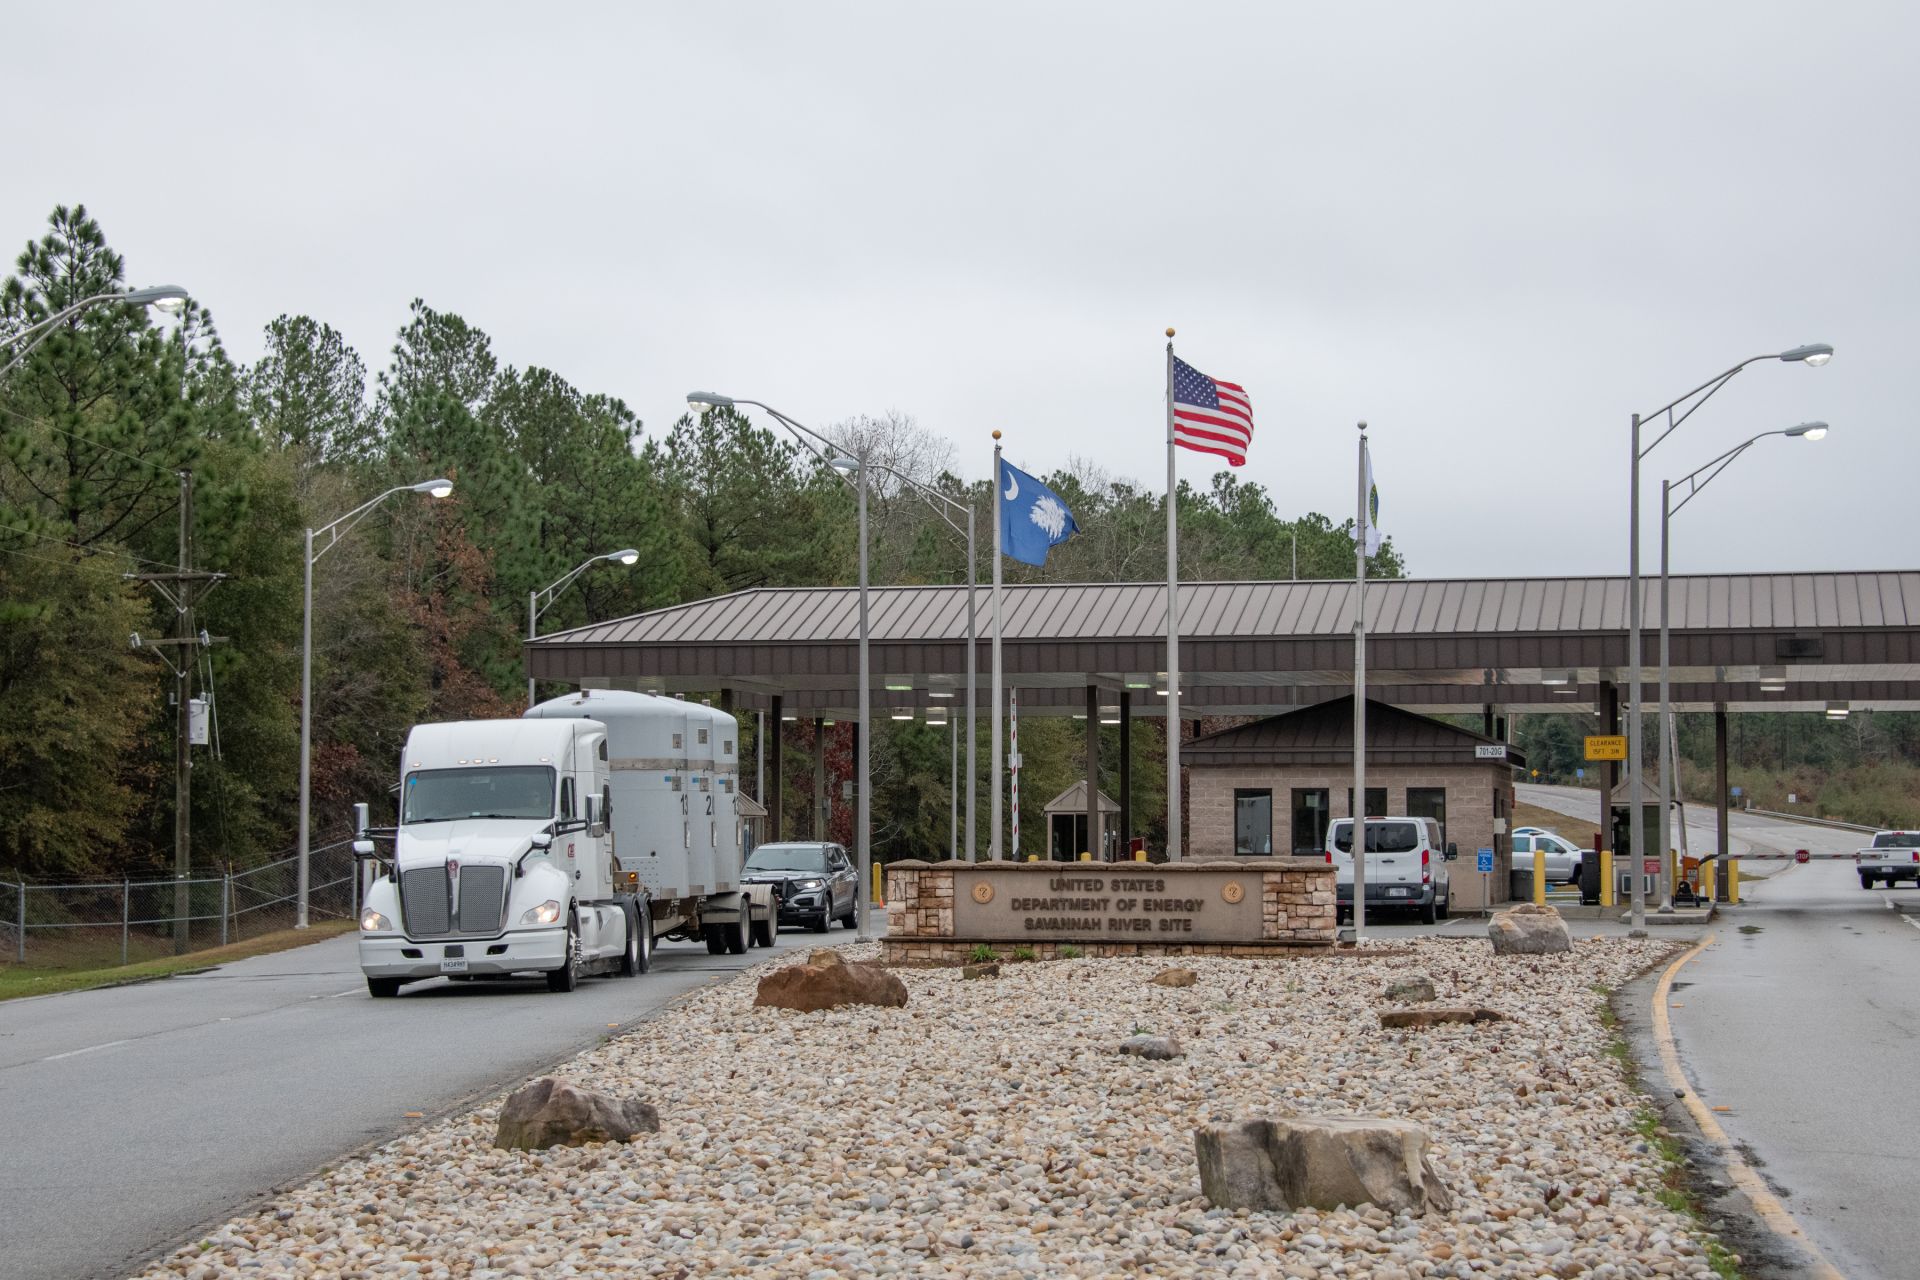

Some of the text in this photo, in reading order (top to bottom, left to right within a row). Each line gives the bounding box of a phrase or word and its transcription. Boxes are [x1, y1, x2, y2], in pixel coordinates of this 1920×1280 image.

[1590, 739, 1622, 747] CLEARANCE
[1479, 747, 1502, 756] 701-20G
[1050, 878, 1165, 893] UNITED STATES
[1011, 898, 1204, 913] DEPARTMENT OF ENERGY
[1024, 917, 1193, 932] SAVANNAH RIVER SITE
